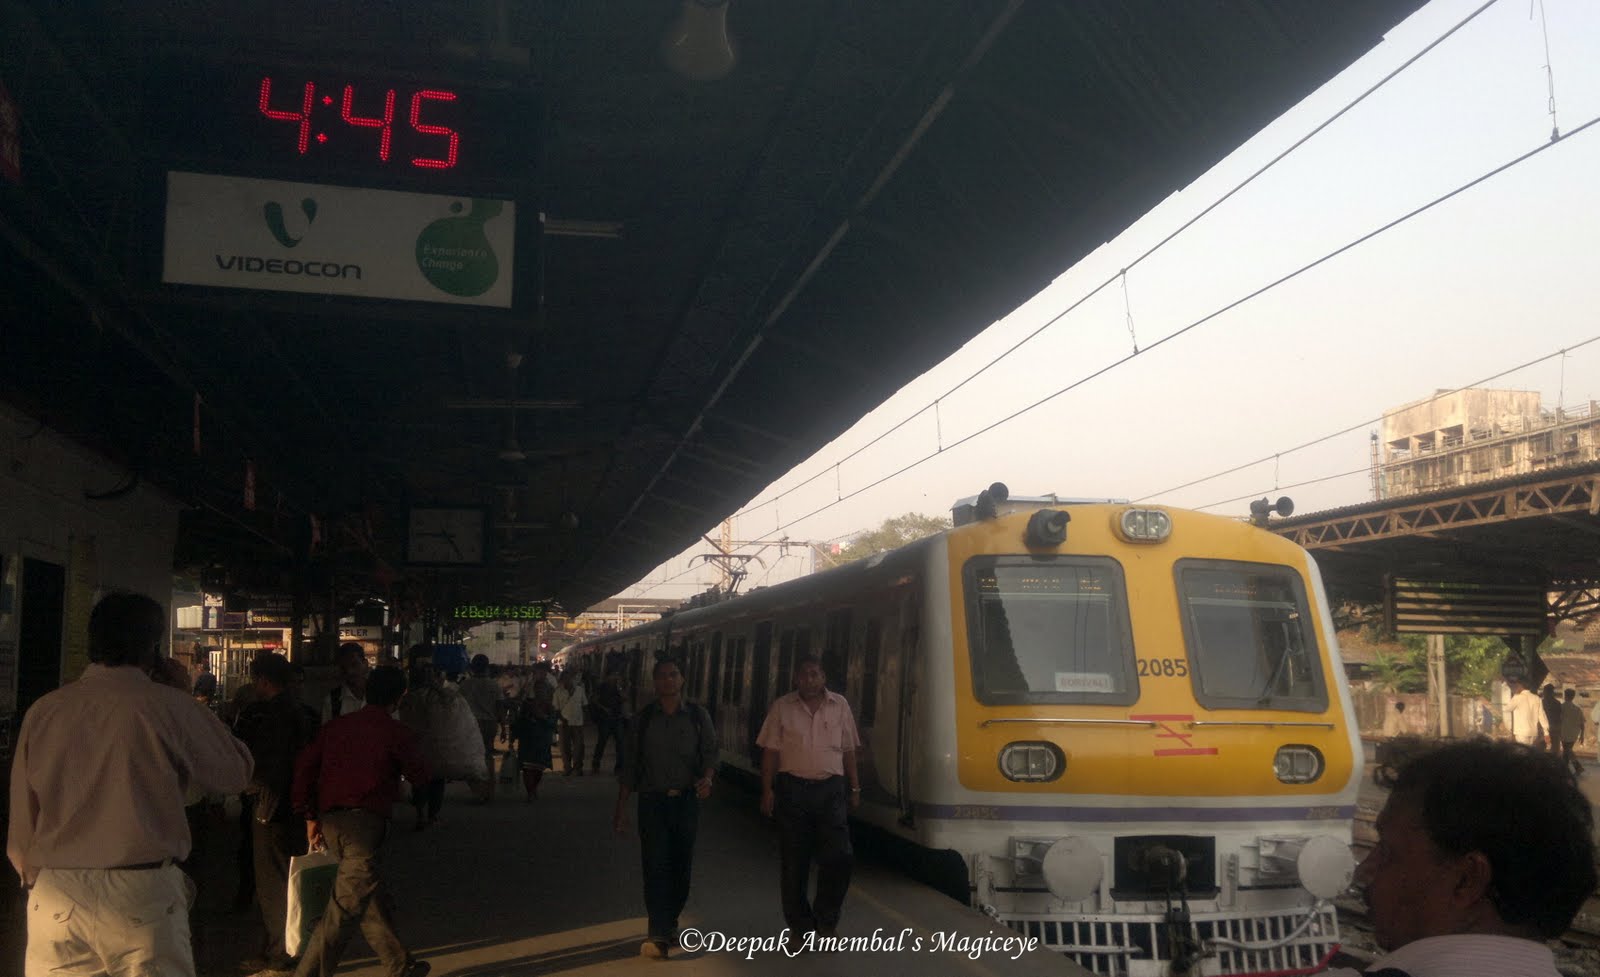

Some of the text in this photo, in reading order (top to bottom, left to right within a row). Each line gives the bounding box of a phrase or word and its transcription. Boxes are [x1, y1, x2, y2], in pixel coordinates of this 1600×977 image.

[259, 76, 460, 169] 4:45
[215, 254, 361, 279] VIDEOCON
[422, 257, 464, 271] Change
[1137, 658, 1188, 677] 2085
